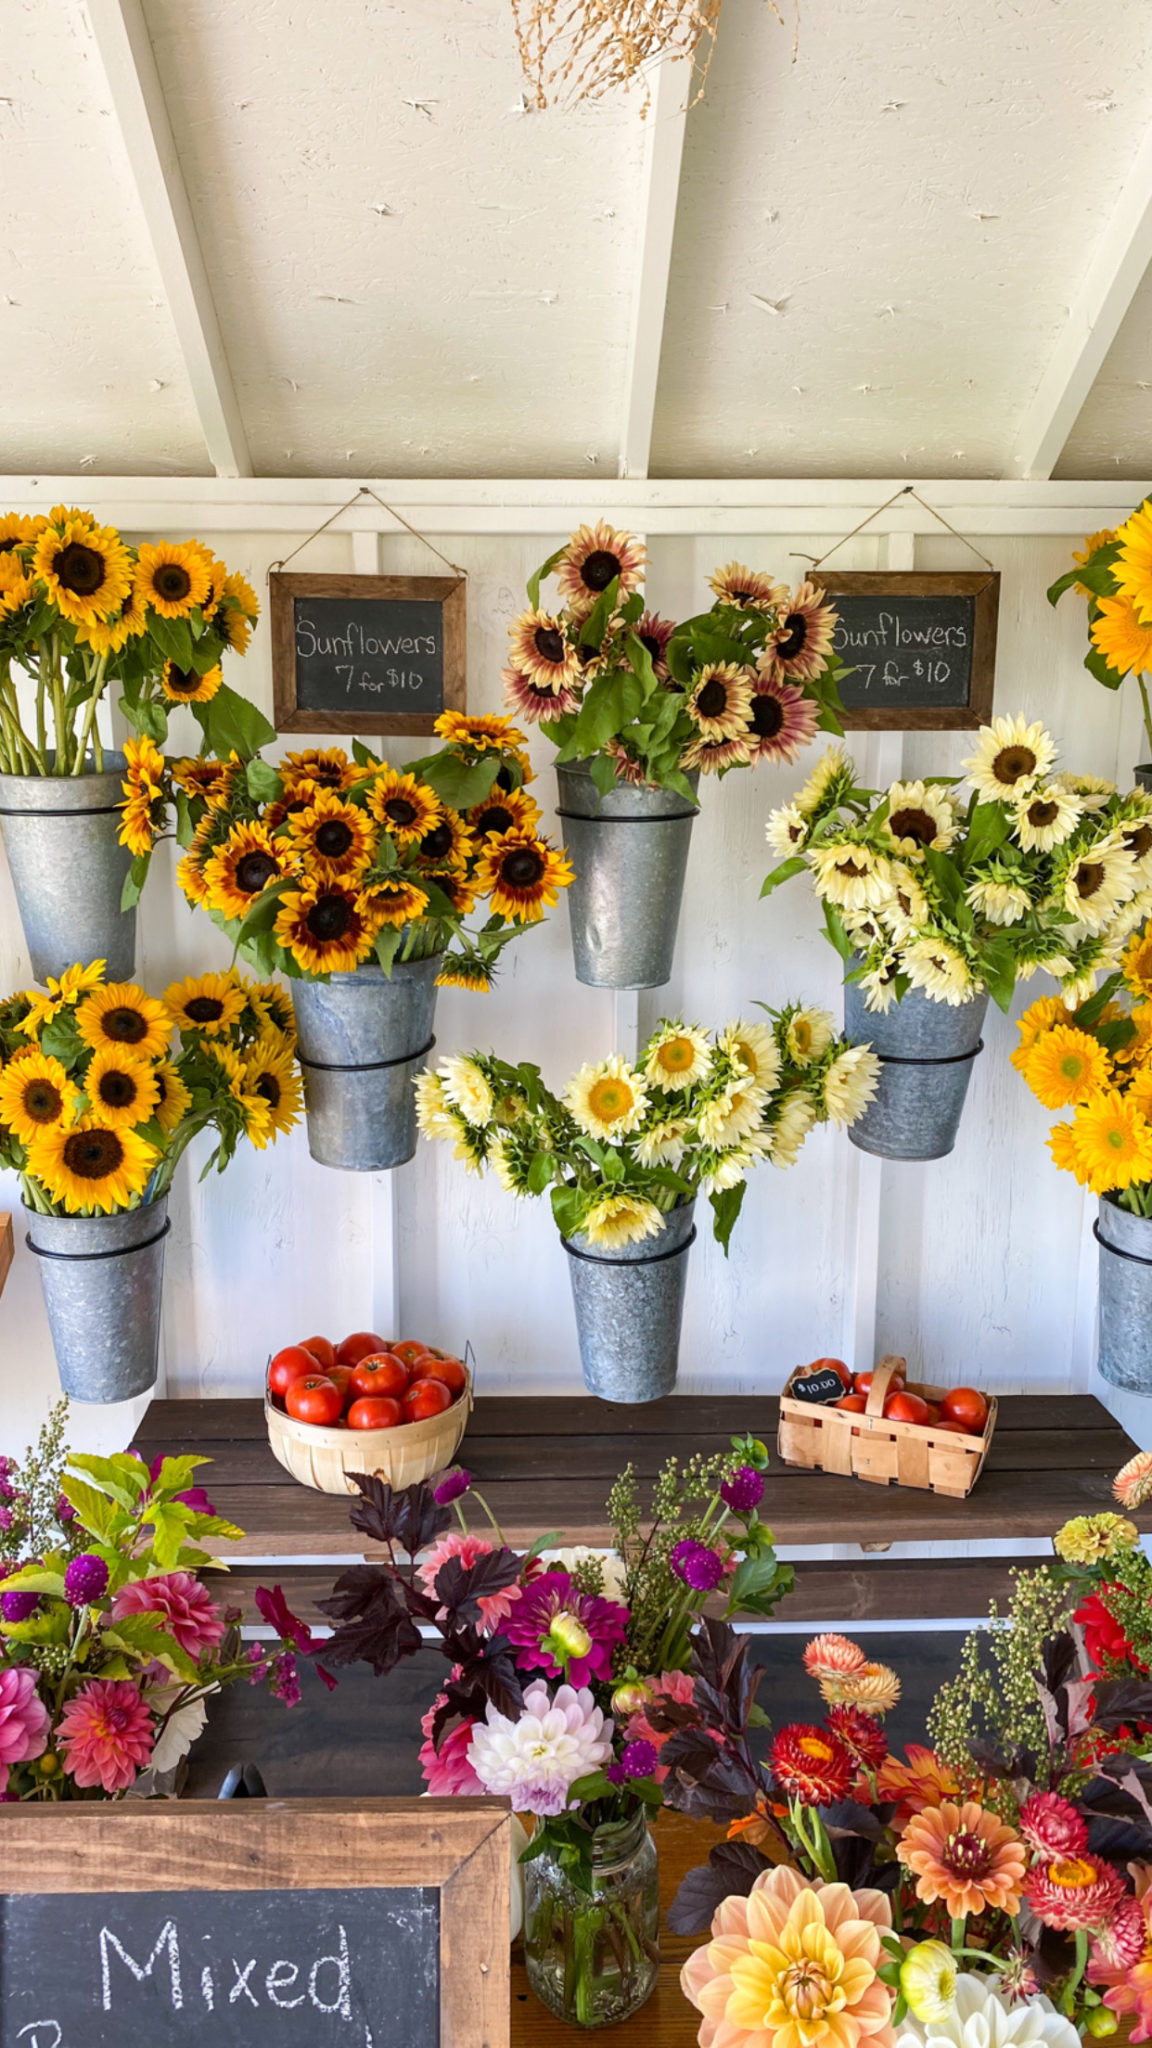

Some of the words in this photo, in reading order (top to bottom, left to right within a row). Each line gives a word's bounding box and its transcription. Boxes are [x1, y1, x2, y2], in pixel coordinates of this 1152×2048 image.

[296, 618, 437, 657] Sunflowers
[833, 612, 967, 650] Sunflowers
[335, 664, 354, 693] 7
[358, 671, 385, 693] for
[386, 668, 423, 690] $10
[855, 664, 876, 689] 7
[882, 660, 909, 686] for
[913, 658, 951, 683] $10
[99, 1920, 352, 2021] Mixed
